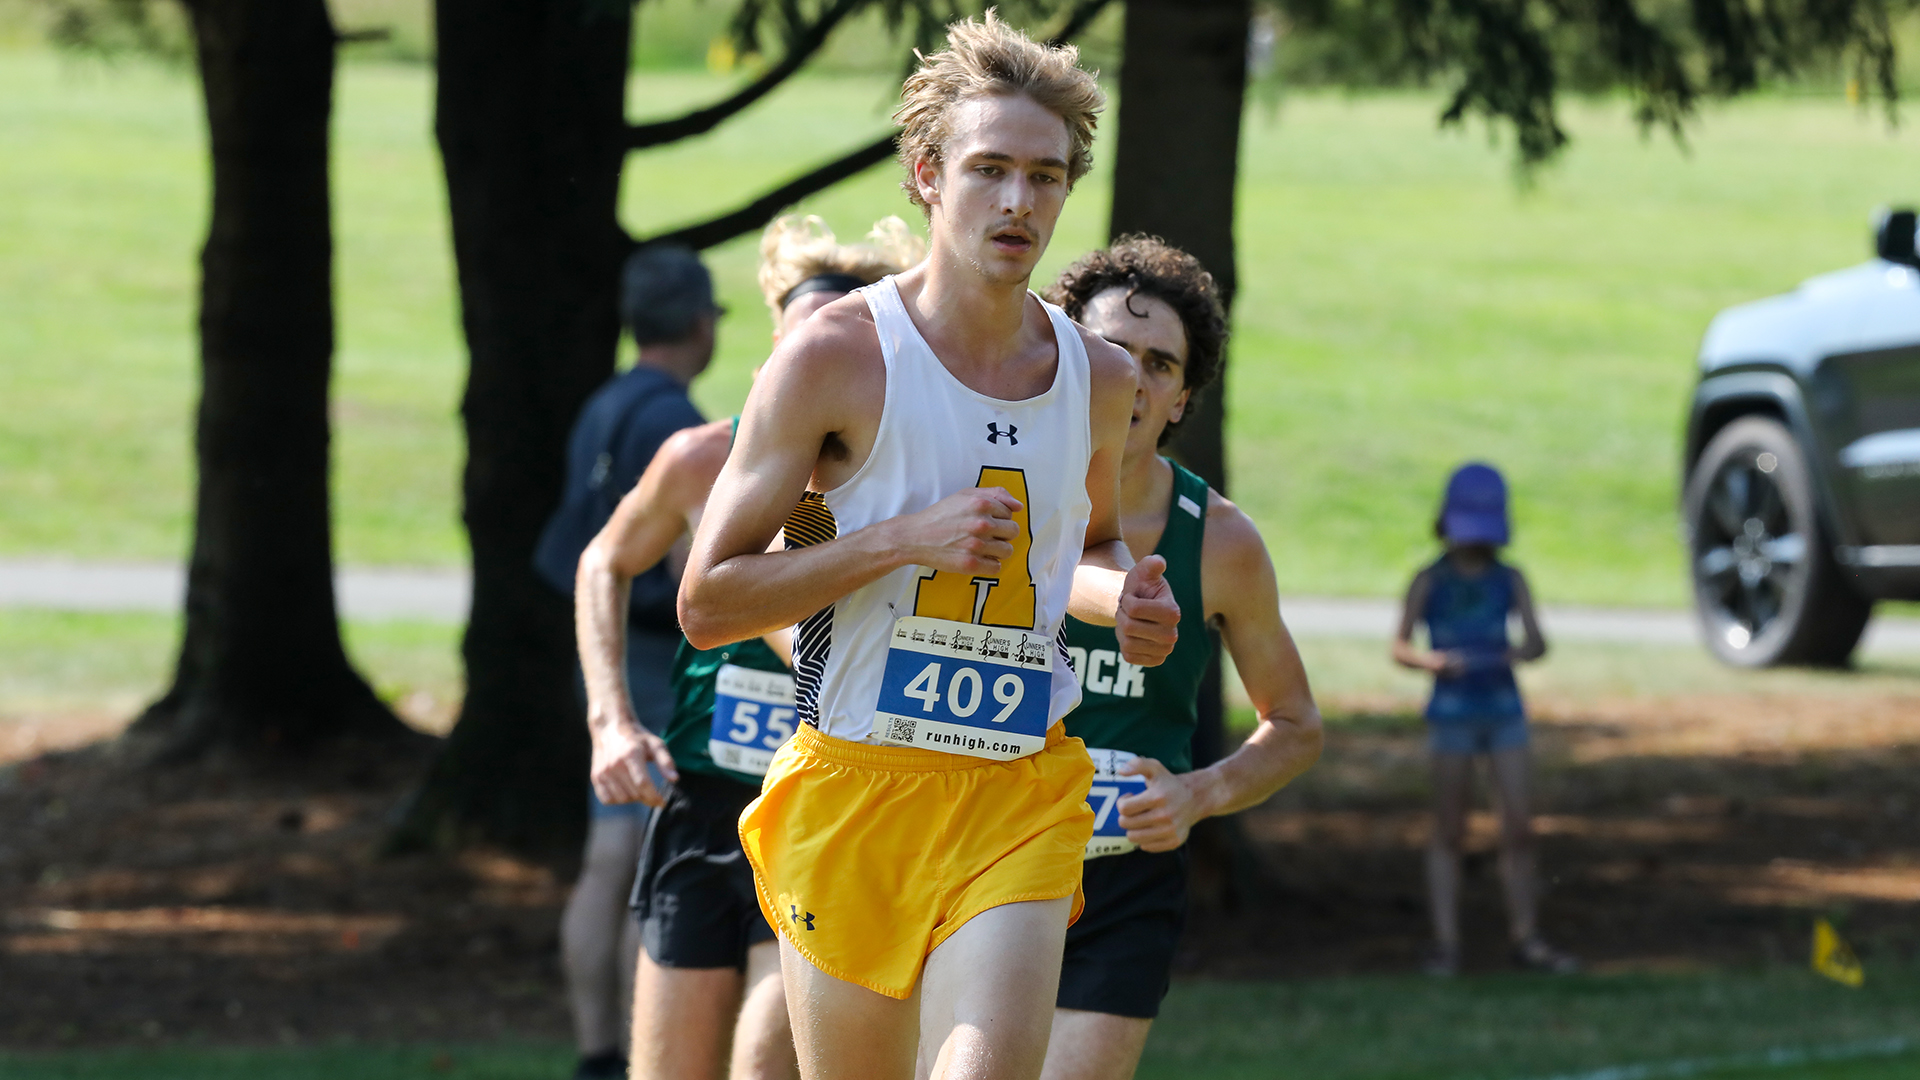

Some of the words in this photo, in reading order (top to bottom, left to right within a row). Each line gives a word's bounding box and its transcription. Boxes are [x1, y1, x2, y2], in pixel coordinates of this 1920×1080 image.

[903, 662, 1025, 723] 409
[728, 701, 796, 749] 55
[926, 731, 1021, 754] runhigh.com
